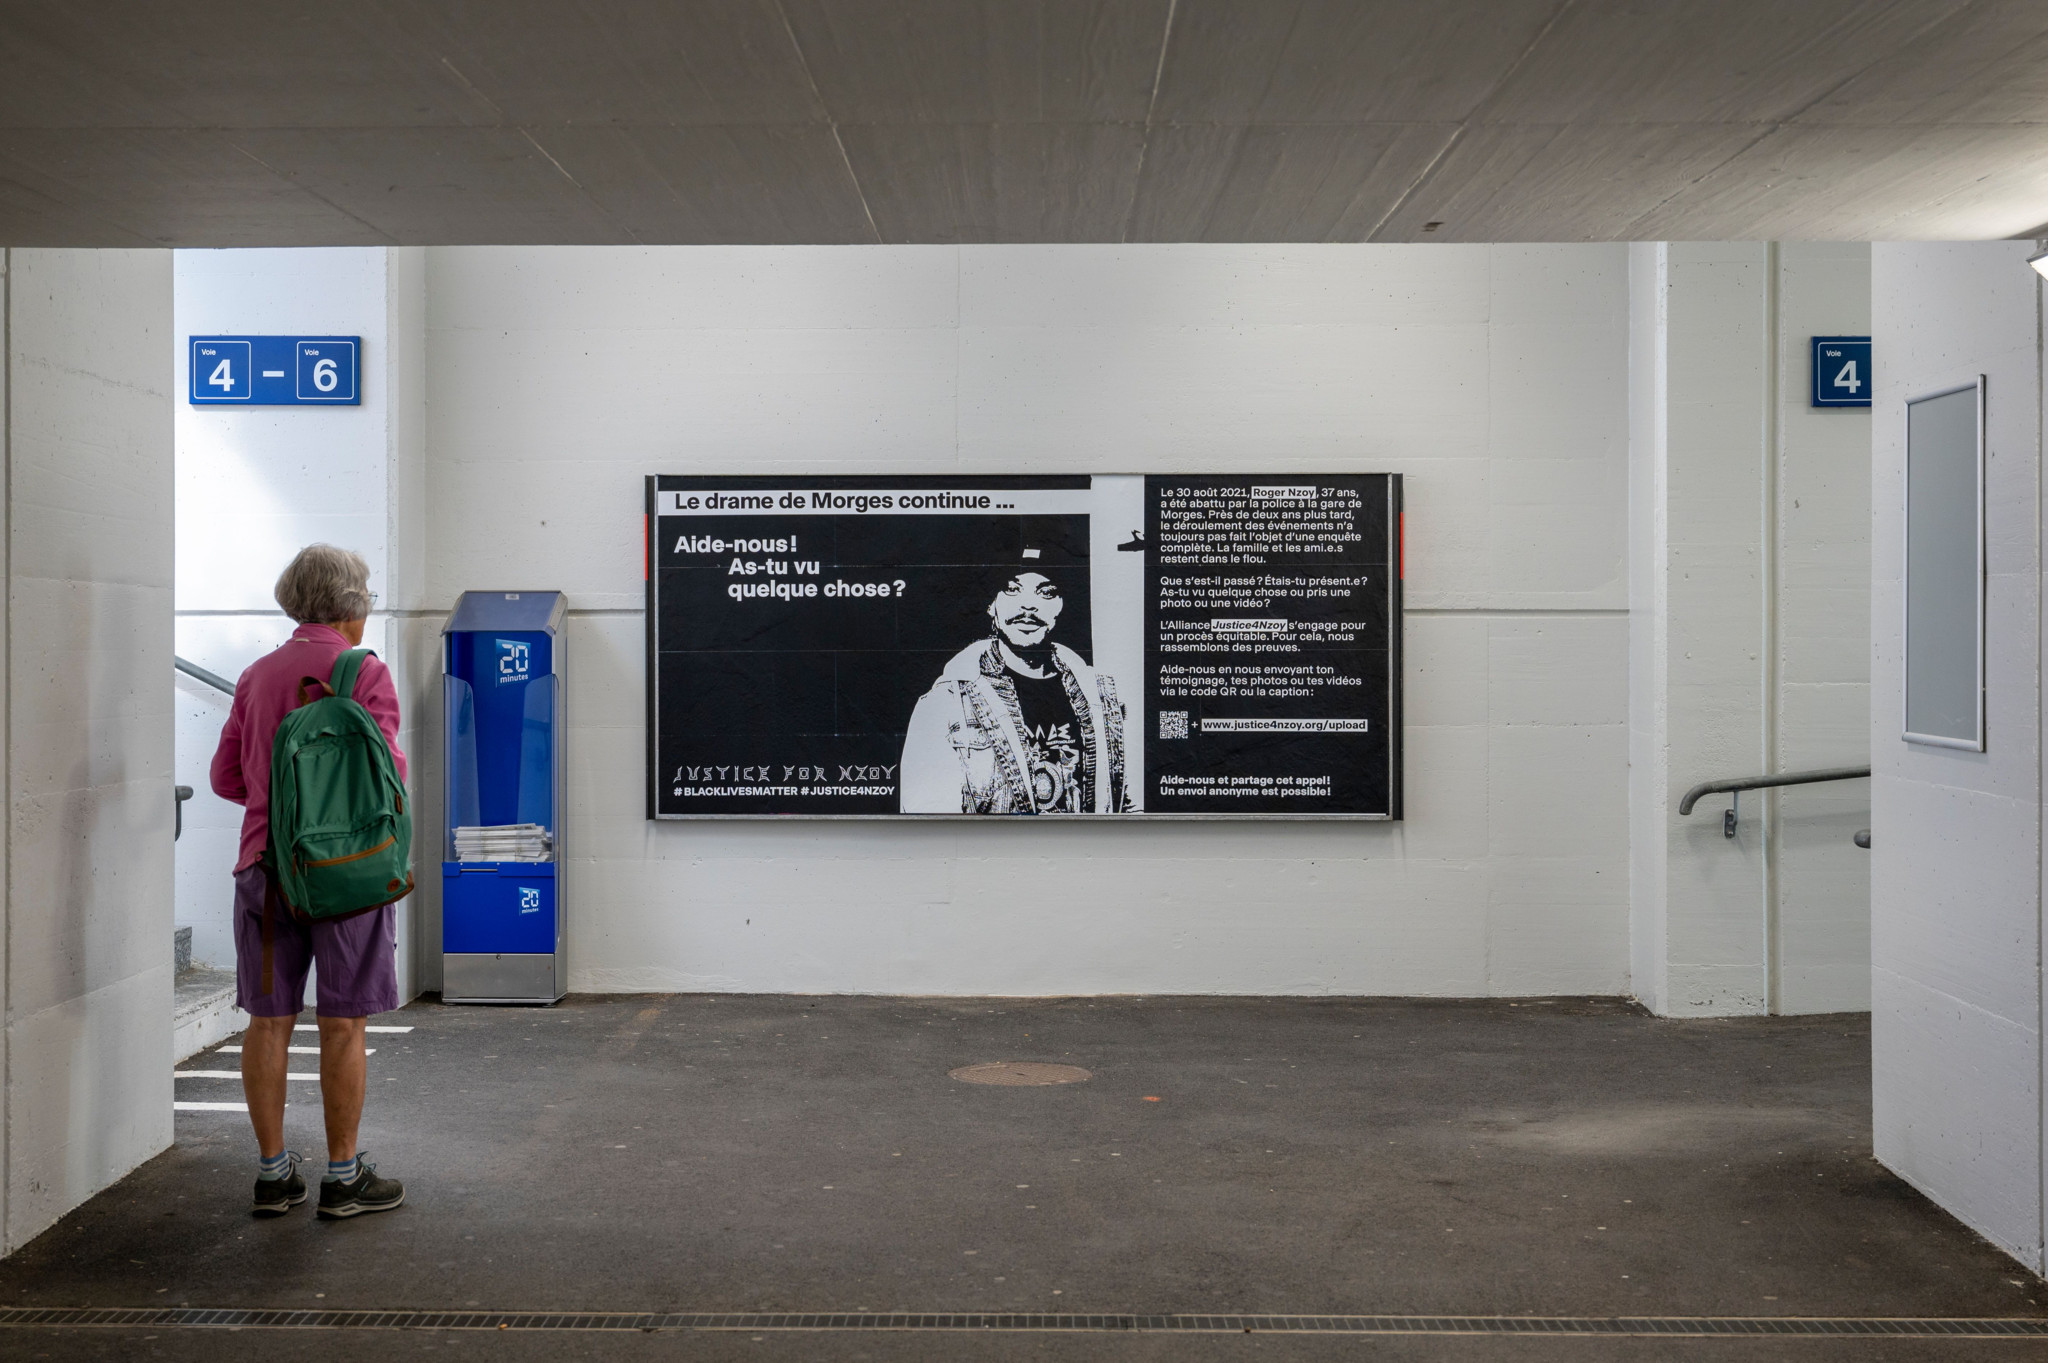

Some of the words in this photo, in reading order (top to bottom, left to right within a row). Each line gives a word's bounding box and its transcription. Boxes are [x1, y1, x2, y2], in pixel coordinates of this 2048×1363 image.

[202, 348, 216, 356] Voie
[305, 348, 319, 356] Voie
[1826, 349, 1841, 357] Voie
[209, 359, 234, 391] 4
[314, 359, 337, 391] 6
[1834, 361, 1861, 393] 4
[1161, 488, 1173, 497] Le
[1177, 488, 1190, 497] 30
[1194, 488, 1217, 497] août
[1221, 488, 1249, 498] 2021,
[1254, 488, 1285, 499] Roger
[1321, 488, 1335, 497] 37
[1337, 489, 1358, 499] ans,
[676, 492, 699, 509] Le
[705, 493, 773, 509] drame
[779, 492, 805, 508] de
[812, 493, 893, 512] Morges
[899, 492, 990, 508] continue
[1161, 500, 1167, 509] a
[1170, 499, 1186, 508] été
[1190, 499, 1225, 508] abattu
[1229, 500, 1246, 510] par
[1250, 499, 1258, 508] la
[1262, 499, 1295, 509] police
[1298, 499, 1304, 508] à
[1308, 499, 1317, 508] la
[1321, 501, 1349, 510] gare
[1351, 499, 1361, 508] de
[1161, 510, 1205, 521] Morges.
[1209, 510, 1233, 519] Près
[1236, 510, 1249, 519] de
[1253, 510, 1278, 519] deux
[1282, 511, 1301, 520] ans
[1304, 510, 1326, 520] plus
[1330, 510, 1354, 520] tard,
[1161, 521, 1170, 530] le
[1173, 521, 1242, 530] déroulement
[1245, 521, 1264, 530] des
[1268, 521, 1333, 530] événements
[1161, 532, 1204, 543] toujours
[1208, 534, 1226, 543] pas
[1229, 532, 1246, 541] fait
[1318, 532, 1361, 543] enquête
[674, 535, 796, 553] Aide-nous!
[1161, 543, 1214, 554] complète.
[1218, 543, 1229, 552] La
[1233, 543, 1269, 552] famille
[1272, 543, 1282, 553] et
[1286, 543, 1301, 552] les
[1304, 543, 1343, 552] ami.e.s
[1161, 554, 1198, 564] restent
[1202, 554, 1227, 563] dans
[1231, 554, 1240, 563] le
[1243, 554, 1266, 563] flou.
[728, 558, 787, 575] As-tu
[794, 562, 819, 574] vu
[1161, 576, 1182, 586] Que
[1265, 576, 1305, 585] Étais-tu
[728, 580, 817, 601] quelque
[824, 580, 906, 597] chose?
[1160, 587, 1189, 597] As-tu
[1192, 588, 1204, 597] vu
[1208, 588, 1251, 598] quelque
[1255, 587, 1287, 597] chose
[1290, 589, 1303, 597] ou
[1307, 588, 1327, 598] pris
[1331, 589, 1350, 597] une
[1161, 599, 1191, 609] photo
[1195, 599, 1207, 608] ou
[1211, 599, 1230, 608] une
[1212, 621, 1287, 632] Justice4Nzoy
[1341, 622, 1366, 632] pour
[1161, 633, 1173, 641] un
[1177, 632, 1213, 642] procès
[1216, 632, 1269, 642] équitable.
[1272, 631, 1297, 641] Pour
[1300, 632, 1324, 642] cela,
[1328, 633, 1354, 641] nous
[1161, 642, 1229, 652] rassemblons
[1232, 642, 1252, 652] des
[1255, 644, 1300, 654] preuves.
[500, 644, 528, 673] 20
[1160, 664, 1215, 674] Aide-nous
[1219, 666, 1231, 674] en
[1235, 666, 1261, 674] nous
[1264, 666, 1313, 675] envoyant
[1316, 665, 1333, 675] ton
[500, 674, 528, 683] minutes
[1160, 676, 1227, 686] témoignage,
[1231, 676, 1247, 686] tes
[1251, 676, 1287, 686] photos
[1291, 677, 1303, 686] ou
[1307, 676, 1323, 686] tes
[1326, 676, 1361, 685] vidéos
[1160, 686, 1175, 696] via
[1179, 687, 1187, 696] le
[1191, 687, 1217, 696] code
[1220, 687, 1236, 696] QR
[1240, 688, 1253, 697] ou
[1257, 687, 1265, 696] la
[1203, 720, 1366, 731] www.justice4nzoy.org/upload
[673, 766, 770, 783] JUSTICE
[783, 765, 827, 781] FOR
[839, 765, 896, 781] NZOY
[1160, 775, 1215, 784] Aide-nous
[1218, 775, 1228, 785] et
[1231, 776, 1273, 786] partage
[1276, 775, 1293, 785] cet
[1296, 776, 1330, 786] appel!
[1161, 786, 1175, 796] Un
[1178, 786, 1206, 796] envoi
[1209, 788, 1259, 797] anonyme
[1262, 786, 1278, 796] est
[1281, 787, 1330, 797] possible!
[522, 890, 538, 908] 20
